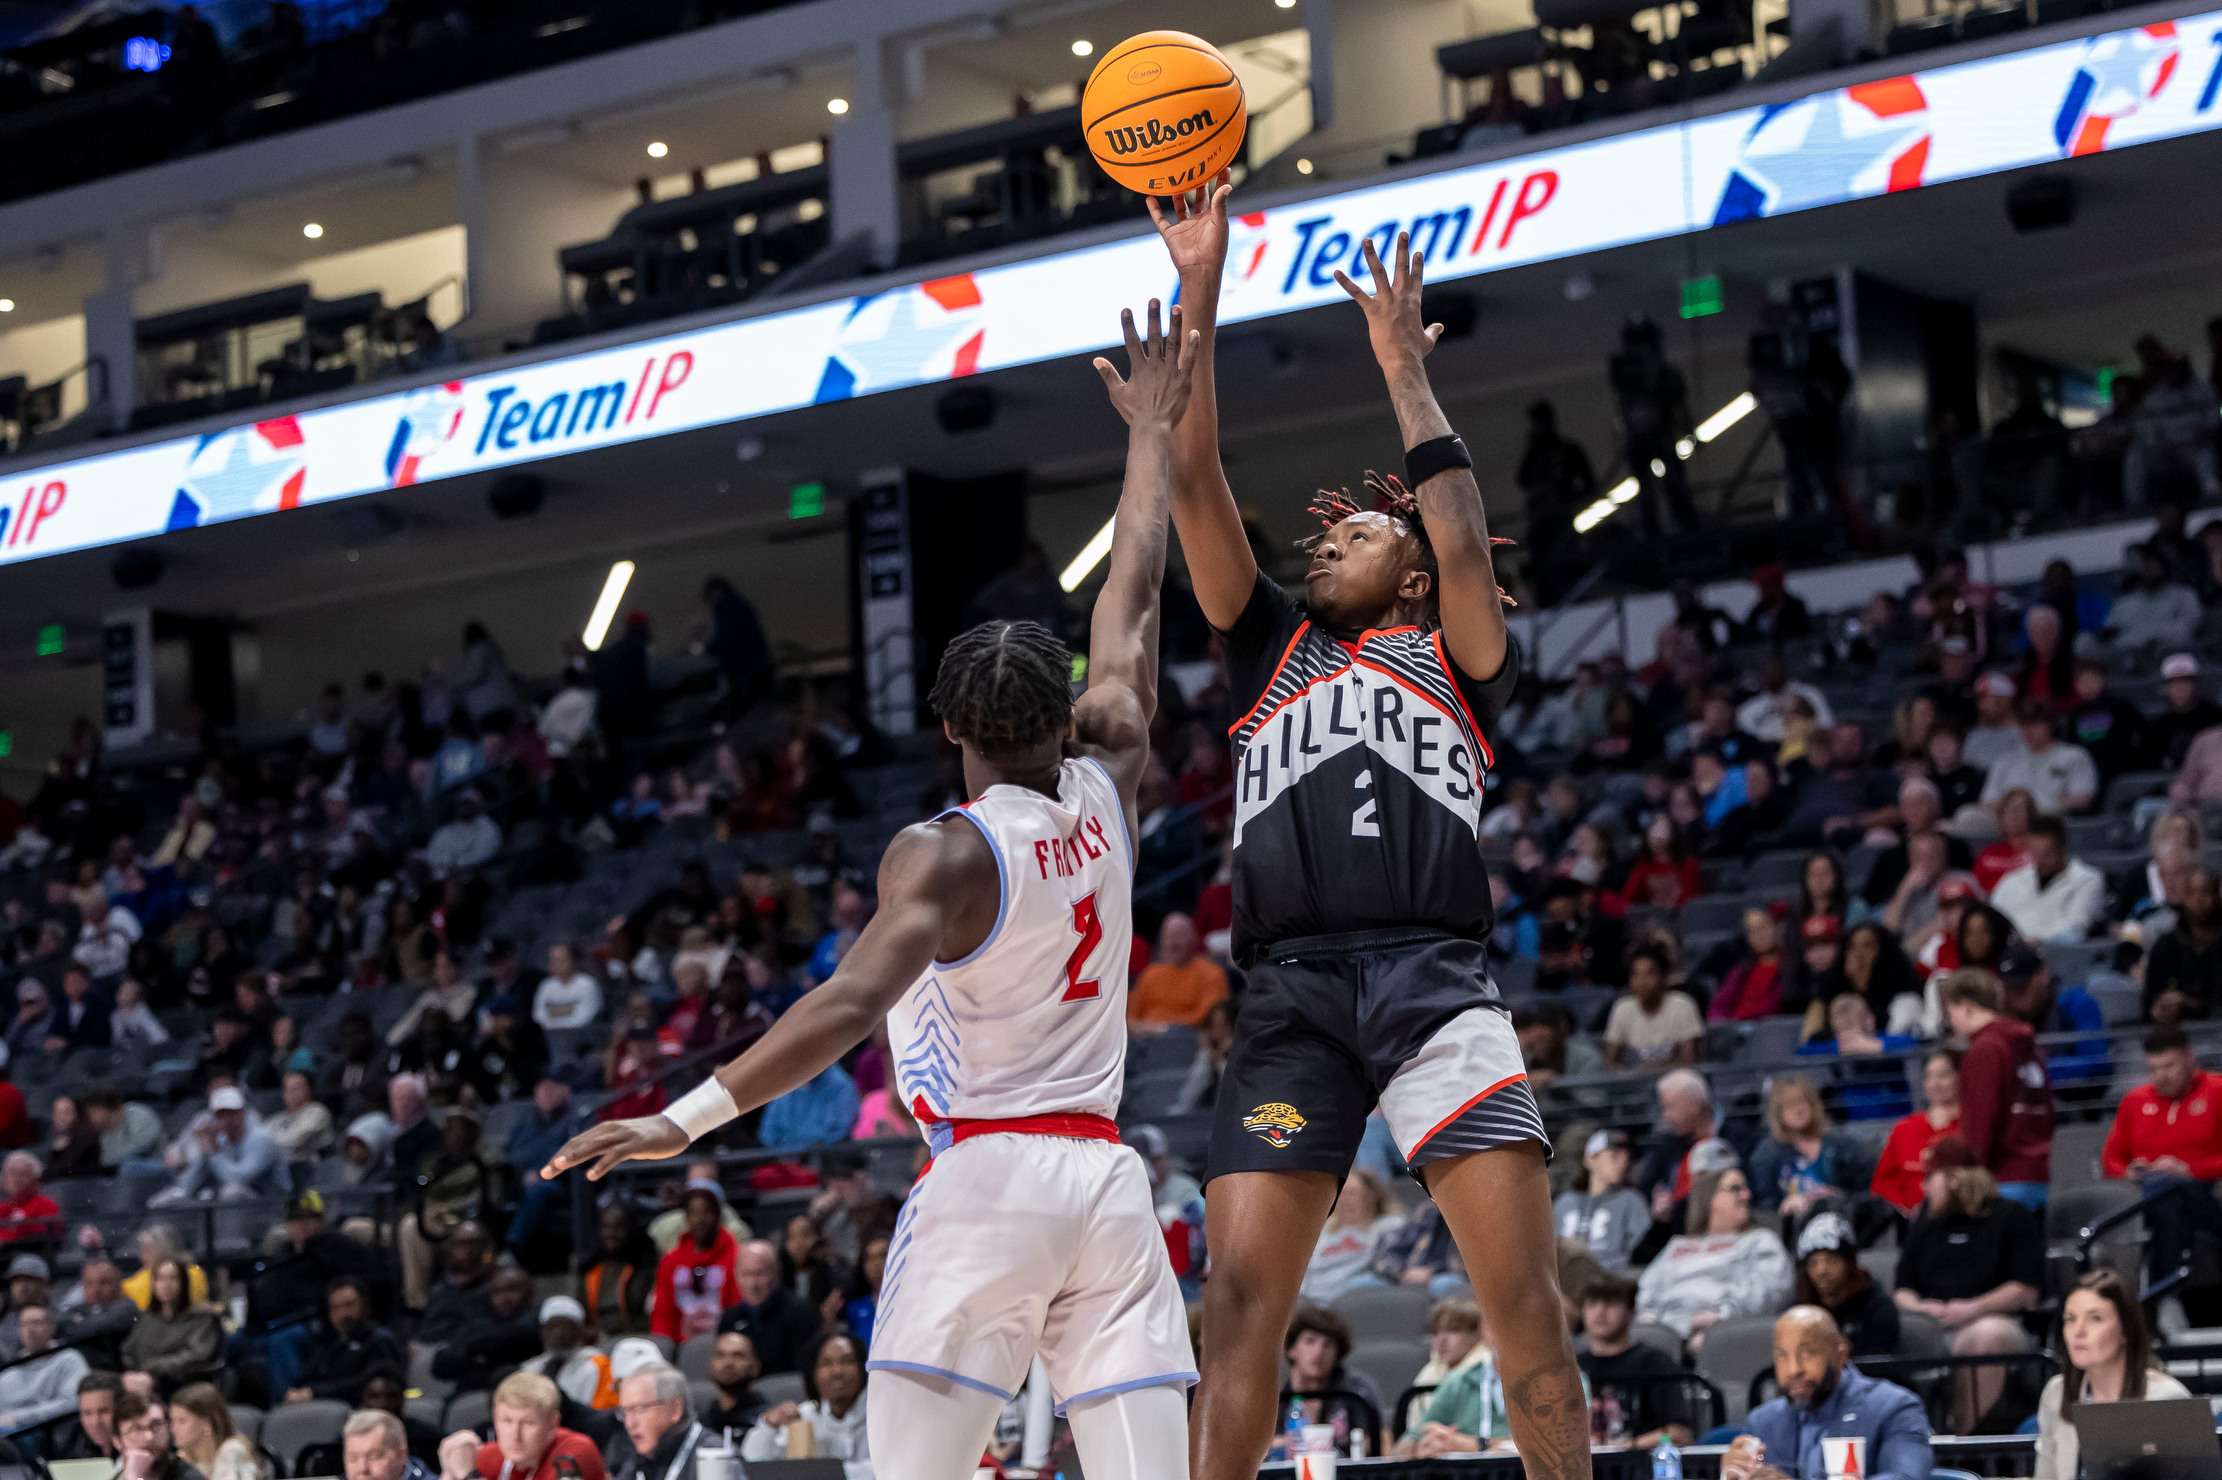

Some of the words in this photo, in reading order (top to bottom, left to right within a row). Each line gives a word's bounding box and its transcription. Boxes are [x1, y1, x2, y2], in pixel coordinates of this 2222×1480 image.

[1105, 109, 1215, 156] Wilson
[1148, 161, 1206, 190] EVO
[1281, 170, 1559, 295] TeamIP
[475, 351, 694, 456] TeamIP
[1351, 769, 1381, 837] 2
[1059, 887, 1102, 1005] 2
